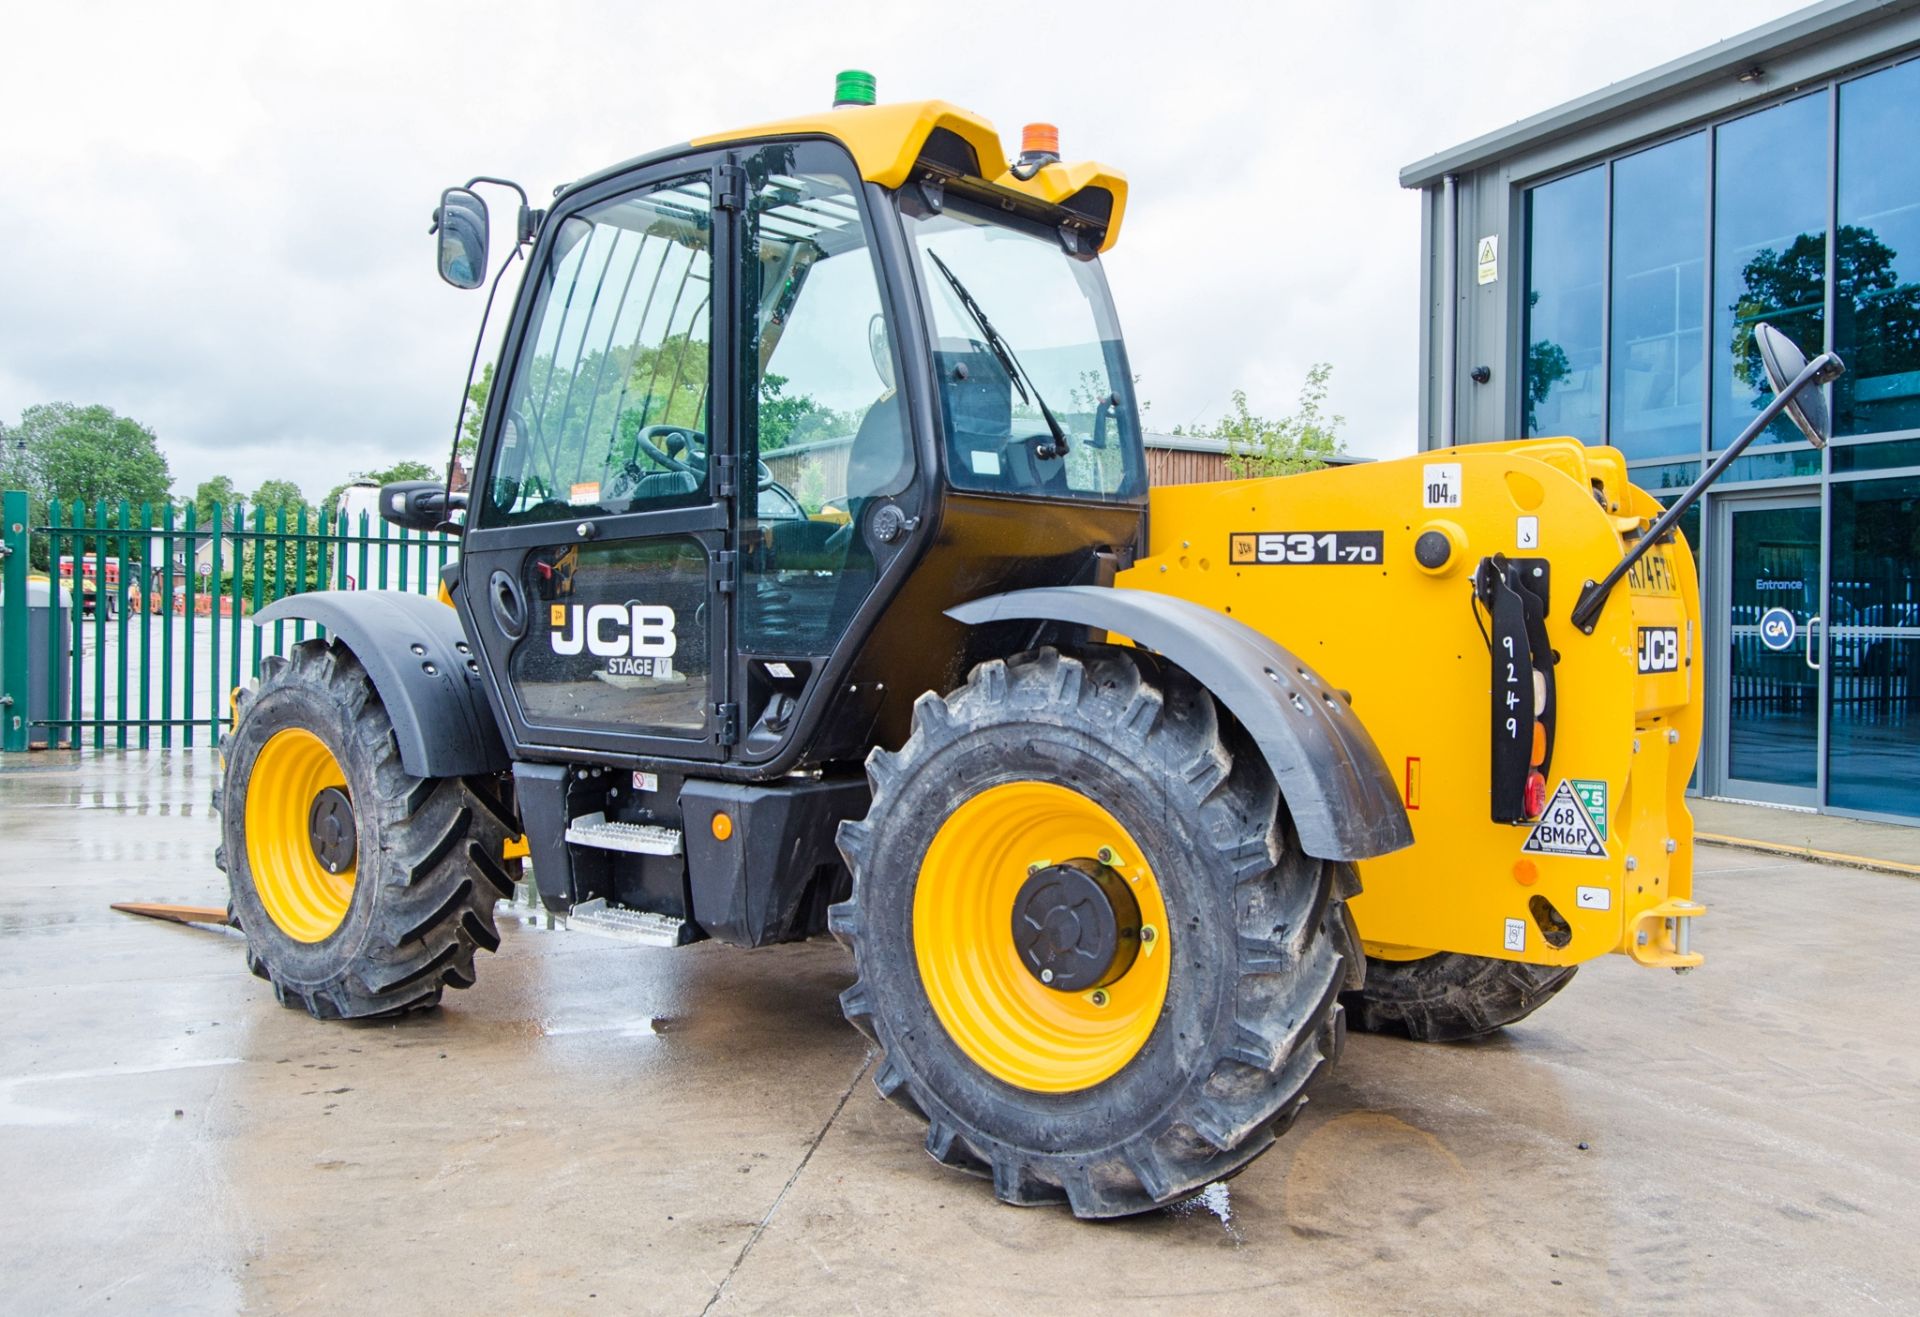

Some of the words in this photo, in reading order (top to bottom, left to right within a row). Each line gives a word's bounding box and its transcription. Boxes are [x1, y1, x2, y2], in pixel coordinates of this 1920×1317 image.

[1427, 483, 1448, 504] 104
[1258, 534, 1376, 562] 531-70
[1756, 578, 1803, 590] Entrance
[551, 604, 677, 657] JCB
[1638, 630, 1678, 671] JCB
[608, 658, 652, 675] STAGE
[659, 660, 668, 675] V
[1591, 791, 1603, 806] 5
[1554, 808, 1575, 826] 68
[1540, 826, 1588, 846] BM6R
